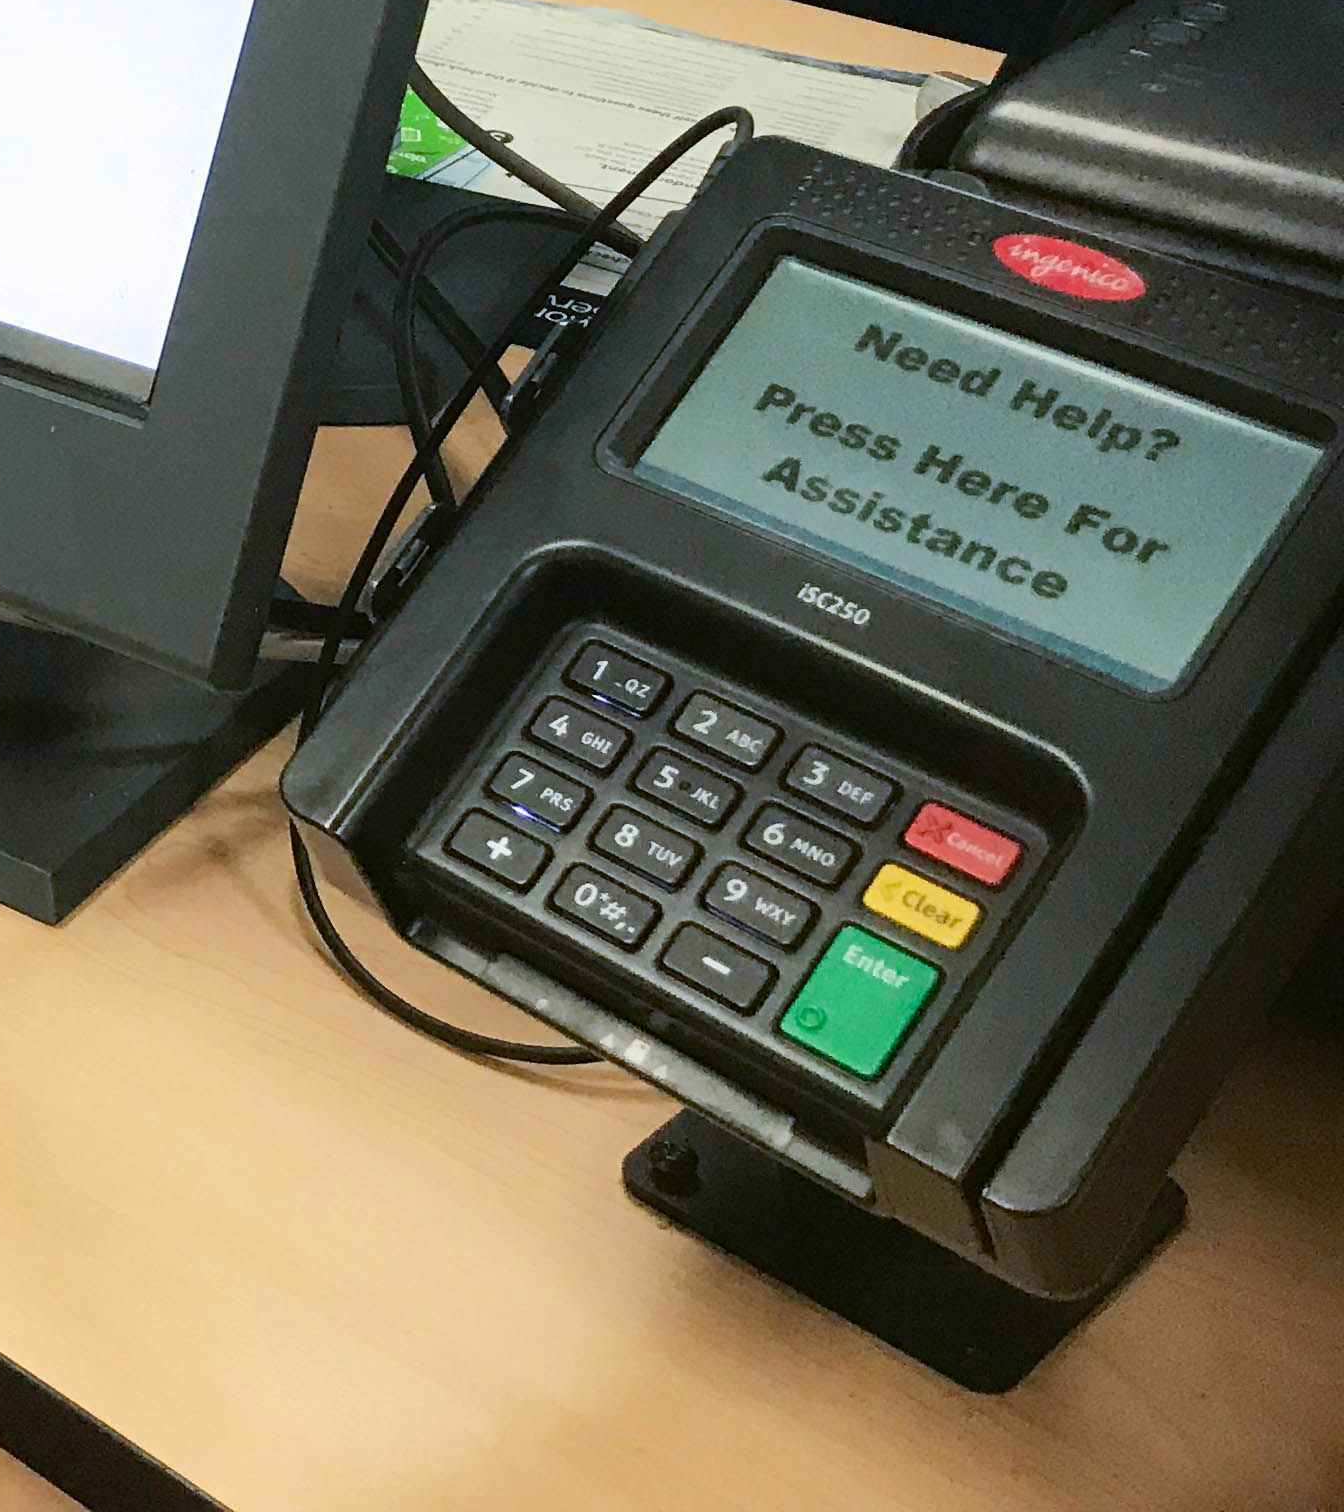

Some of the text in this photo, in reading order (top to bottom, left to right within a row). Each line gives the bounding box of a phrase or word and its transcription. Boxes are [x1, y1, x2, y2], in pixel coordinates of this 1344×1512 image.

[1006, 236, 1130, 293] ingenico
[855, 322, 1181, 463] Need Help?
[753, 381, 1170, 566] Press Here For
[762, 454, 1069, 601] Assistance
[797, 580, 872, 626] iSC250
[592, 660, 609, 682] 1
[548, 714, 613, 755] 4 GHI
[693, 709, 761, 754] 2 ABC
[510, 768, 573, 814] 7 PRS
[653, 765, 721, 810] 5 JKL
[803, 760, 875, 806] 3 DEF
[614, 823, 683, 867] 8 TUV
[762, 821, 836, 868] 6 MNO
[945, 830, 1003, 869] Cancel
[725, 879, 797, 928] 9 WXY
[901, 887, 963, 931] Clear
[842, 942, 910, 991] Enter
